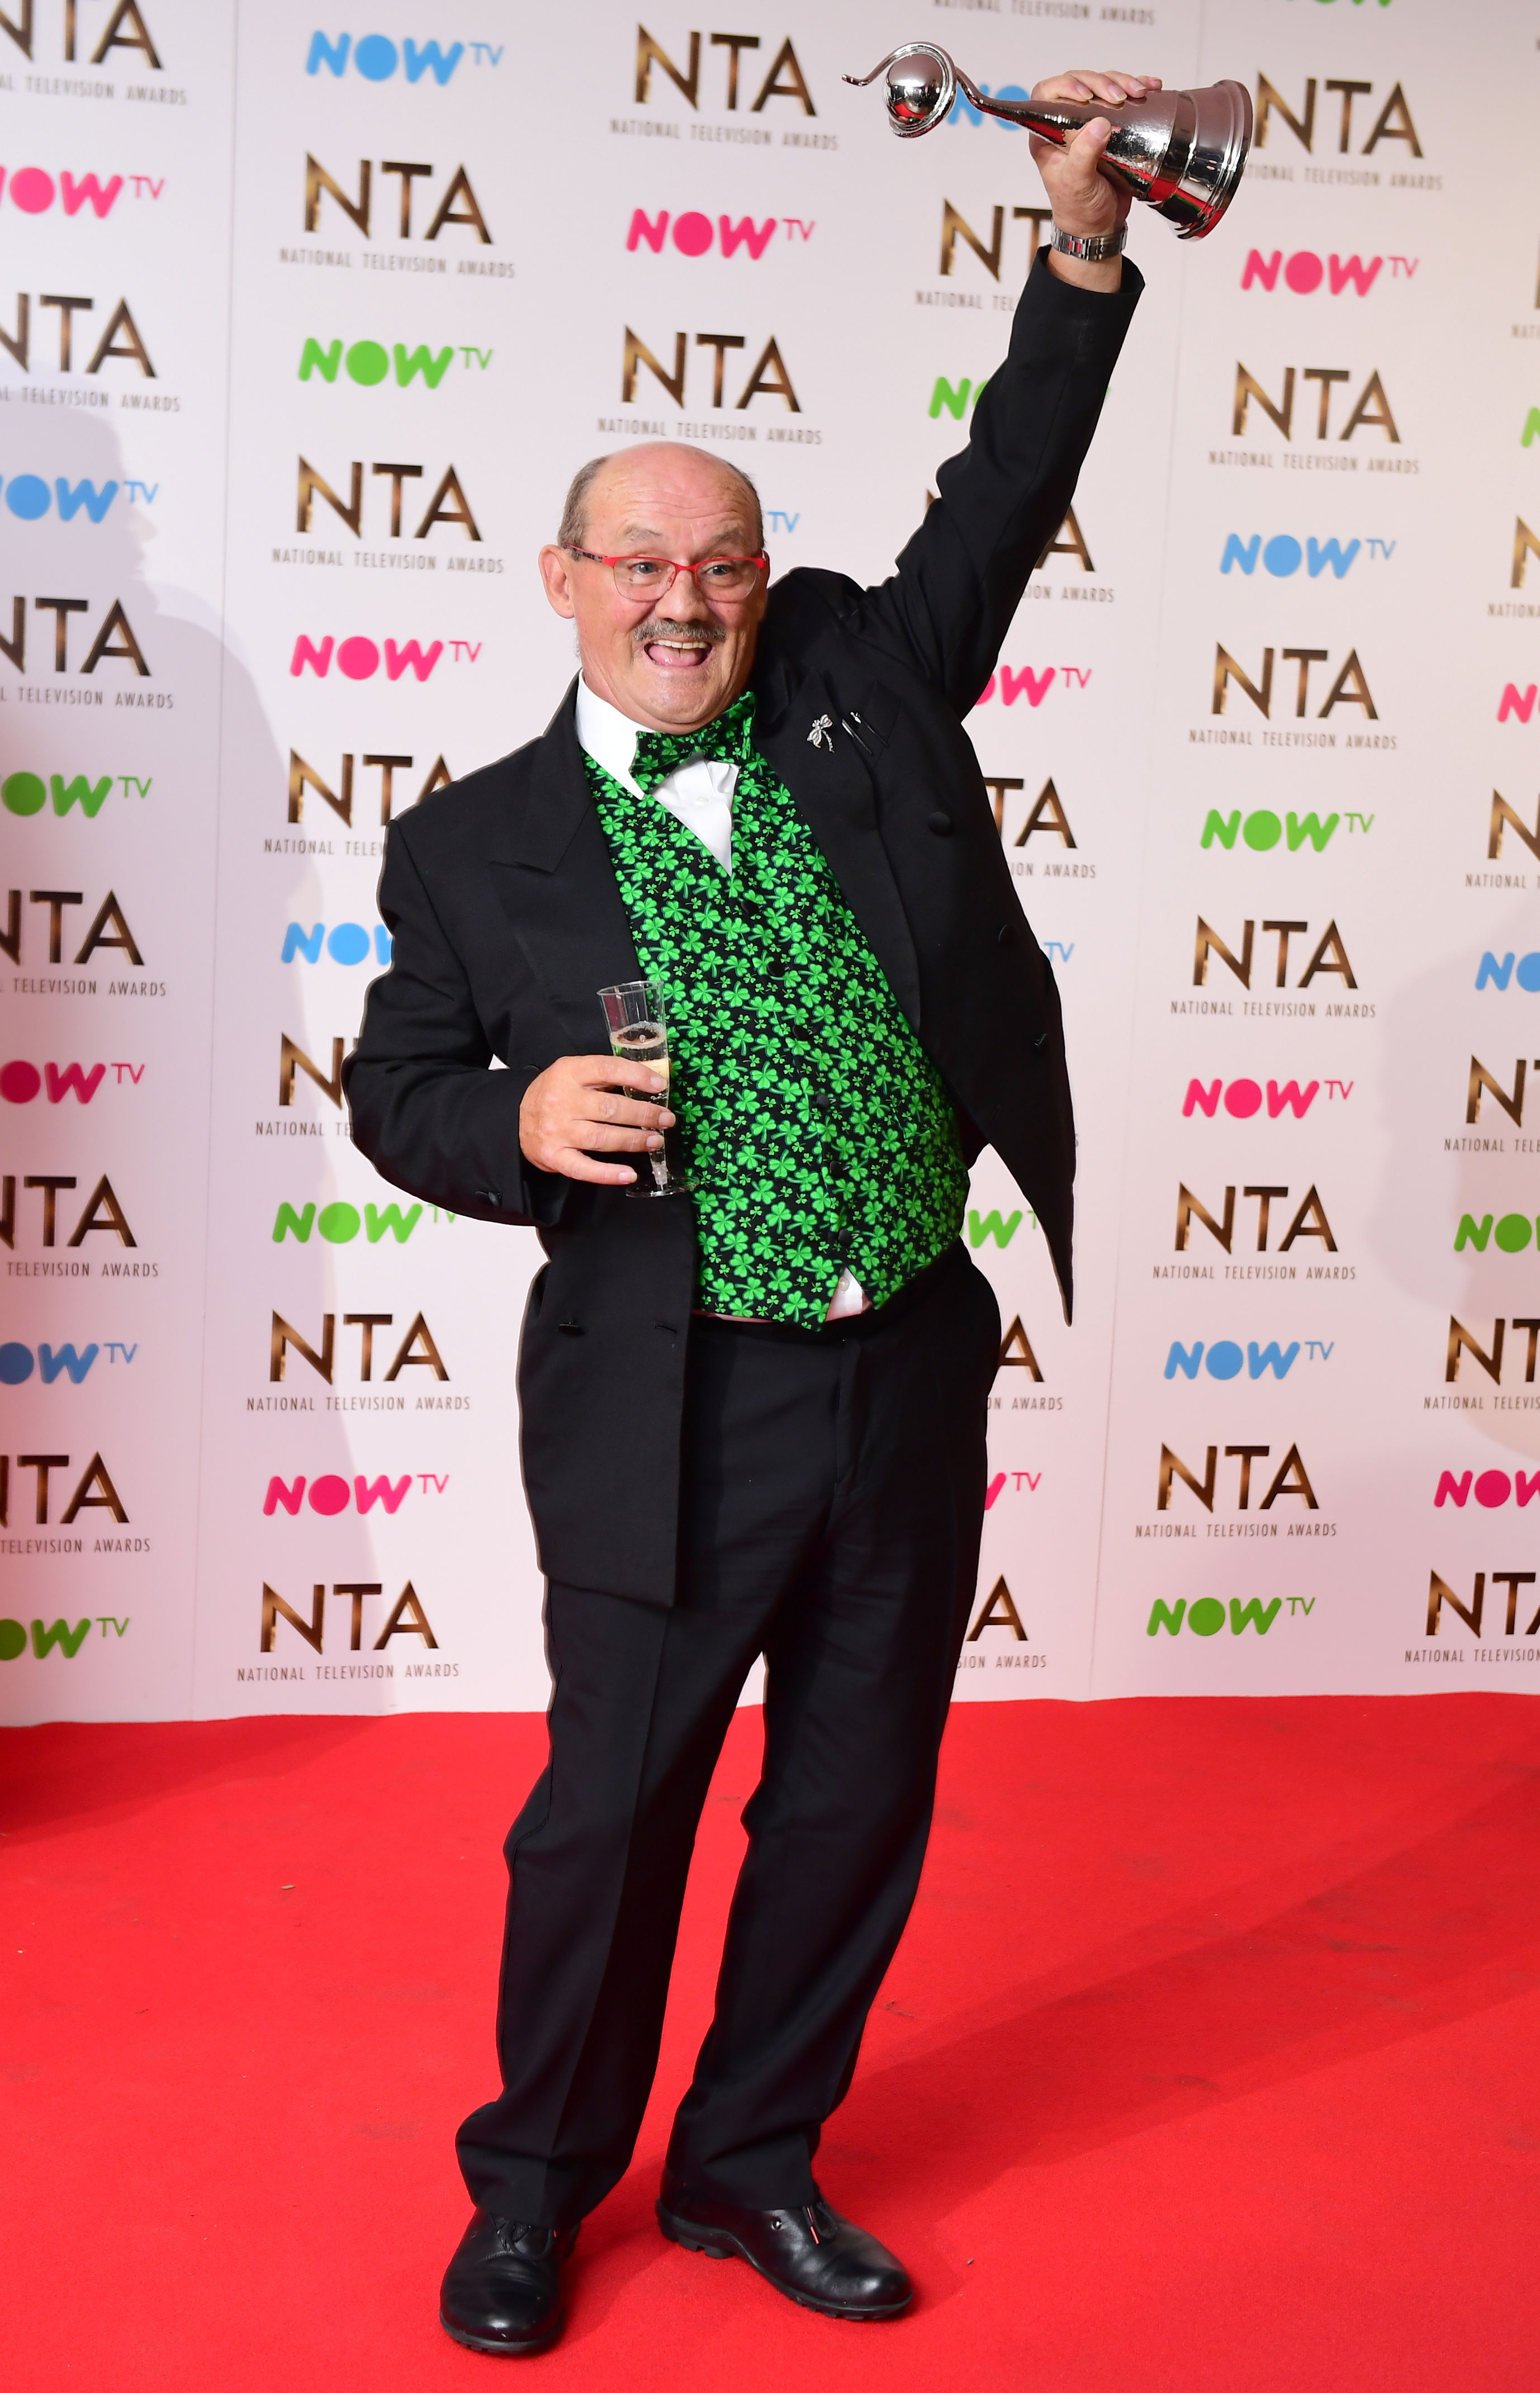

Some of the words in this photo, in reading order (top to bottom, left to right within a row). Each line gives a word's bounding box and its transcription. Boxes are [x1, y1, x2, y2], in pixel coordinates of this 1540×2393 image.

[306, 30, 465, 86] NOW
[471, 42, 503, 65] TV
[634, 23, 818, 117] NTA
[26, 76, 114, 99] TELEVISION
[126, 86, 187, 106] AWARDS
[610, 119, 680, 139] NATIONAL
[690, 124, 772, 145] TELEVISION
[781, 132, 838, 150] AWARDS
[1253, 71, 1424, 159] NTA
[0, 165, 125, 219] OW
[130, 176, 164, 199] TV
[304, 151, 494, 245] NTA
[1305, 165, 1381, 186] TELEVISION
[1389, 173, 1443, 191] AWARDS
[625, 208, 778, 260] NOW
[783, 218, 815, 241] TV
[940, 198, 1053, 283] NT
[279, 248, 352, 268] NATIONAL
[363, 253, 446, 273] TELEVISION
[457, 260, 515, 278] AWARDS
[1240, 249, 1383, 297] NOW
[1389, 257, 1418, 277] TV
[915, 291, 983, 309] NATIONAL
[298, 337, 454, 389] NOW
[459, 347, 492, 369] TV
[622, 325, 802, 413] NTA
[22, 387, 108, 407] TELEVISION
[121, 394, 180, 413] AWARDS
[1231, 361, 1401, 444] NTA
[598, 418, 666, 436] NATIONAL
[677, 422, 756, 440] TELEVISION
[766, 428, 822, 445] AWARDS
[1209, 451, 1273, 468] NATIONAL
[1283, 453, 1358, 471] TELEVISION
[1367, 458, 1420, 475] AWARDS
[0, 474, 119, 523] OW
[124, 481, 158, 503] TV
[296, 455, 483, 542] NTA
[767, 511, 799, 533] TV
[272, 548, 344, 566] NATIONAL
[354, 551, 436, 570] TELEVISION
[447, 557, 504, 574] AWARDS
[1220, 533, 1361, 579] NOW
[1365, 539, 1396, 560] TV
[1061, 587, 1115, 603] AWARDS
[290, 634, 444, 683] NOW
[448, 640, 482, 662] TV
[1060, 667, 1092, 688] TV
[18, 686, 103, 705] TELEVISION
[115, 691, 173, 709] AWARDS
[1211, 642, 1380, 721] NTA
[1188, 729, 1252, 745] NATIONAL
[1263, 731, 1336, 748] TELEVISION
[1345, 735, 1397, 750] AWARDS
[0, 771, 113, 818] OW
[117, 776, 152, 798] TV
[983, 776, 1078, 849] TA
[264, 838, 334, 855] NATIONAL
[1200, 809, 1340, 852] NOW
[1344, 813, 1375, 833] TV
[1044, 864, 1096, 878] AWARDS
[1465, 873, 1527, 889] NATIONAL
[1044, 942, 1075, 963] TV
[1192, 915, 1358, 991] NTA
[1475, 951, 1540, 992] NO
[13, 977, 96, 995] TELEVISION
[108, 980, 166, 997] AWARDS
[1171, 1000, 1233, 1015] NATIONAL
[1243, 1002, 1316, 1017] TELEVISION
[1325, 1003, 1376, 1018] AWARDS
[0, 1060, 106, 1105] OW
[111, 1063, 145, 1084] TV
[1182, 1078, 1320, 1119] NOW
[1324, 1080, 1354, 1100] TV
[255, 1121, 324, 1136] NATIONAL
[1444, 1138, 1504, 1153] NATIONAL
[0, 1173, 138, 1250] TA
[272, 1202, 422, 1243] NOW
[1174, 1182, 1338, 1255] NTA
[1453, 1213, 1540, 1253] NO
[7, 1261, 89, 1277] TELEVISION
[101, 1262, 159, 1277] AWARDS
[1153, 1266, 1215, 1279] NATIONAL
[1224, 1266, 1296, 1280] TELEVISION
[1306, 1266, 1356, 1280] AWARDS
[0, 1342, 99, 1385] OW
[103, 1343, 138, 1363] TV
[270, 1310, 451, 1386] NTA
[1164, 1341, 1300, 1380] NOW
[1304, 1341, 1334, 1361] TV
[1446, 1314, 1540, 1386] NT
[247, 1397, 315, 1411] NATIONAL
[326, 1396, 405, 1411] TELEVISION
[415, 1396, 470, 1410] AWARDS
[1011, 1397, 1063, 1410] AWARDS
[1424, 1396, 1484, 1410] NATIONAL
[1493, 1396, 1540, 1410] TELEVIS
[0, 1451, 130, 1528] TA
[263, 1474, 413, 1516] NOW
[416, 1473, 450, 1495] TV
[1011, 1472, 1041, 1491] TV
[1157, 1442, 1320, 1514] NTA
[0, 1538, 82, 1555] TELEVISION
[93, 1538, 150, 1553] AWARDS
[1135, 1524, 1197, 1538] NATIONAL
[1206, 1524, 1278, 1538] TELEVISION
[1287, 1523, 1337, 1537] AWARDS
[260, 1580, 439, 1655] NTA
[1146, 1597, 1282, 1636] NOW
[1285, 1596, 1316, 1617] TV
[1425, 1569, 1540, 1638] NT
[0, 1618, 91, 1661] OW
[95, 1617, 130, 1638] TV
[1405, 1649, 1464, 1663] NATIONAL
[237, 1667, 305, 1681] NATIONAL
[315, 1665, 394, 1680] TELEVISION
[405, 1664, 459, 1678] AWARDS
[995, 1655, 1046, 1668] AWARDS
